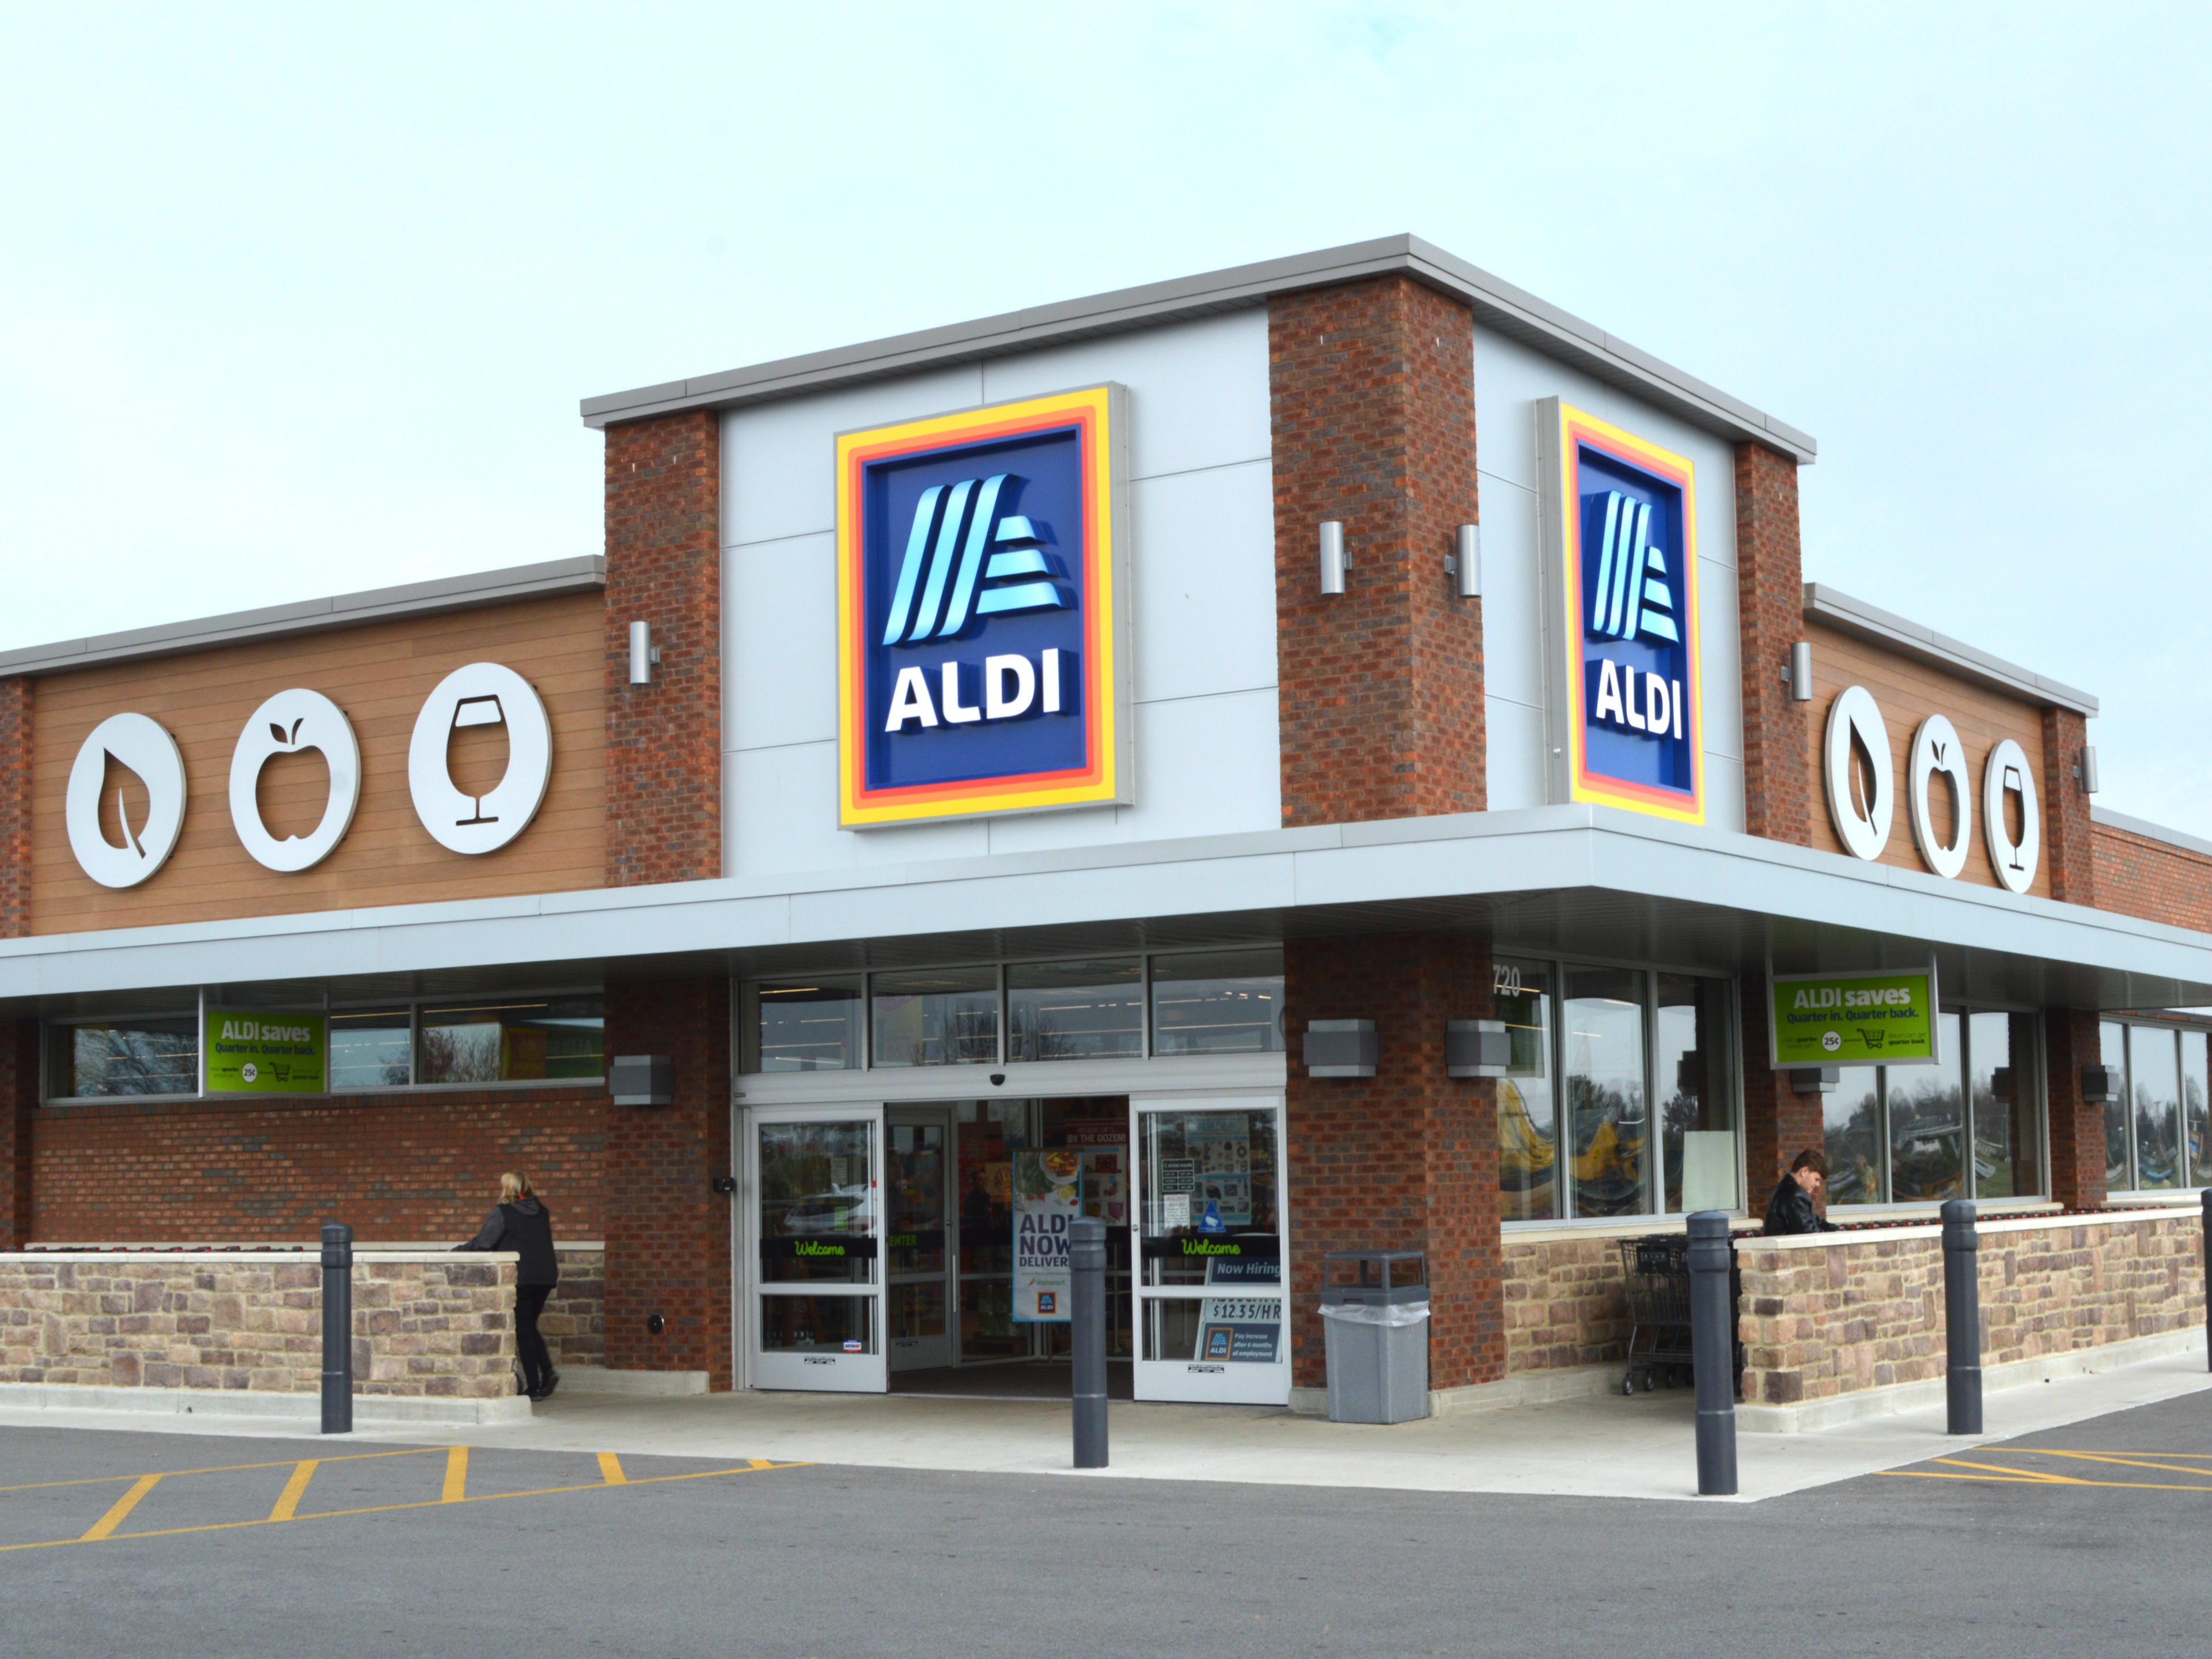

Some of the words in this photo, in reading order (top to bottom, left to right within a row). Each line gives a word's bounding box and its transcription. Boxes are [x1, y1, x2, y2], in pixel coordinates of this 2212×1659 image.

[885, 647, 1060, 732] ALDI
[1596, 658, 1682, 740] ALDI
[1493, 964, 1521, 997] 720
[1794, 988, 1842, 1009] ALDI
[1845, 988, 1911, 1007] saves
[1787, 1012, 1827, 1023] Quarter
[1831, 1010, 1843, 1020] in.
[1846, 1009, 1887, 1021] Quarter
[1890, 1007, 1919, 1018] back.
[221, 1020, 259, 1039] ALDI
[262, 1025, 310, 1042] saves
[215, 1043, 248, 1054] Quarter
[249, 1043, 260, 1053] in.
[262, 1044, 293, 1055] Quarter
[294, 1045, 316, 1055] back.
[1824, 1037, 1839, 1046] 25¢
[1067, 1135, 1078, 1143] BY
[1080, 1134, 1095, 1142] THE
[1097, 1134, 1126, 1142] DOZEN!
[1019, 1214, 1073, 1234] ALD
[794, 1240, 845, 1255] Welcome
[889, 1234, 917, 1246] ENTER
[1020, 1236, 1071, 1255] NOW
[1181, 1238, 1241, 1255] Welcome
[1019, 1256, 1070, 1267] DELIVER
[1217, 1263, 1244, 1274] Now
[1247, 1262, 1281, 1276] Hiring
